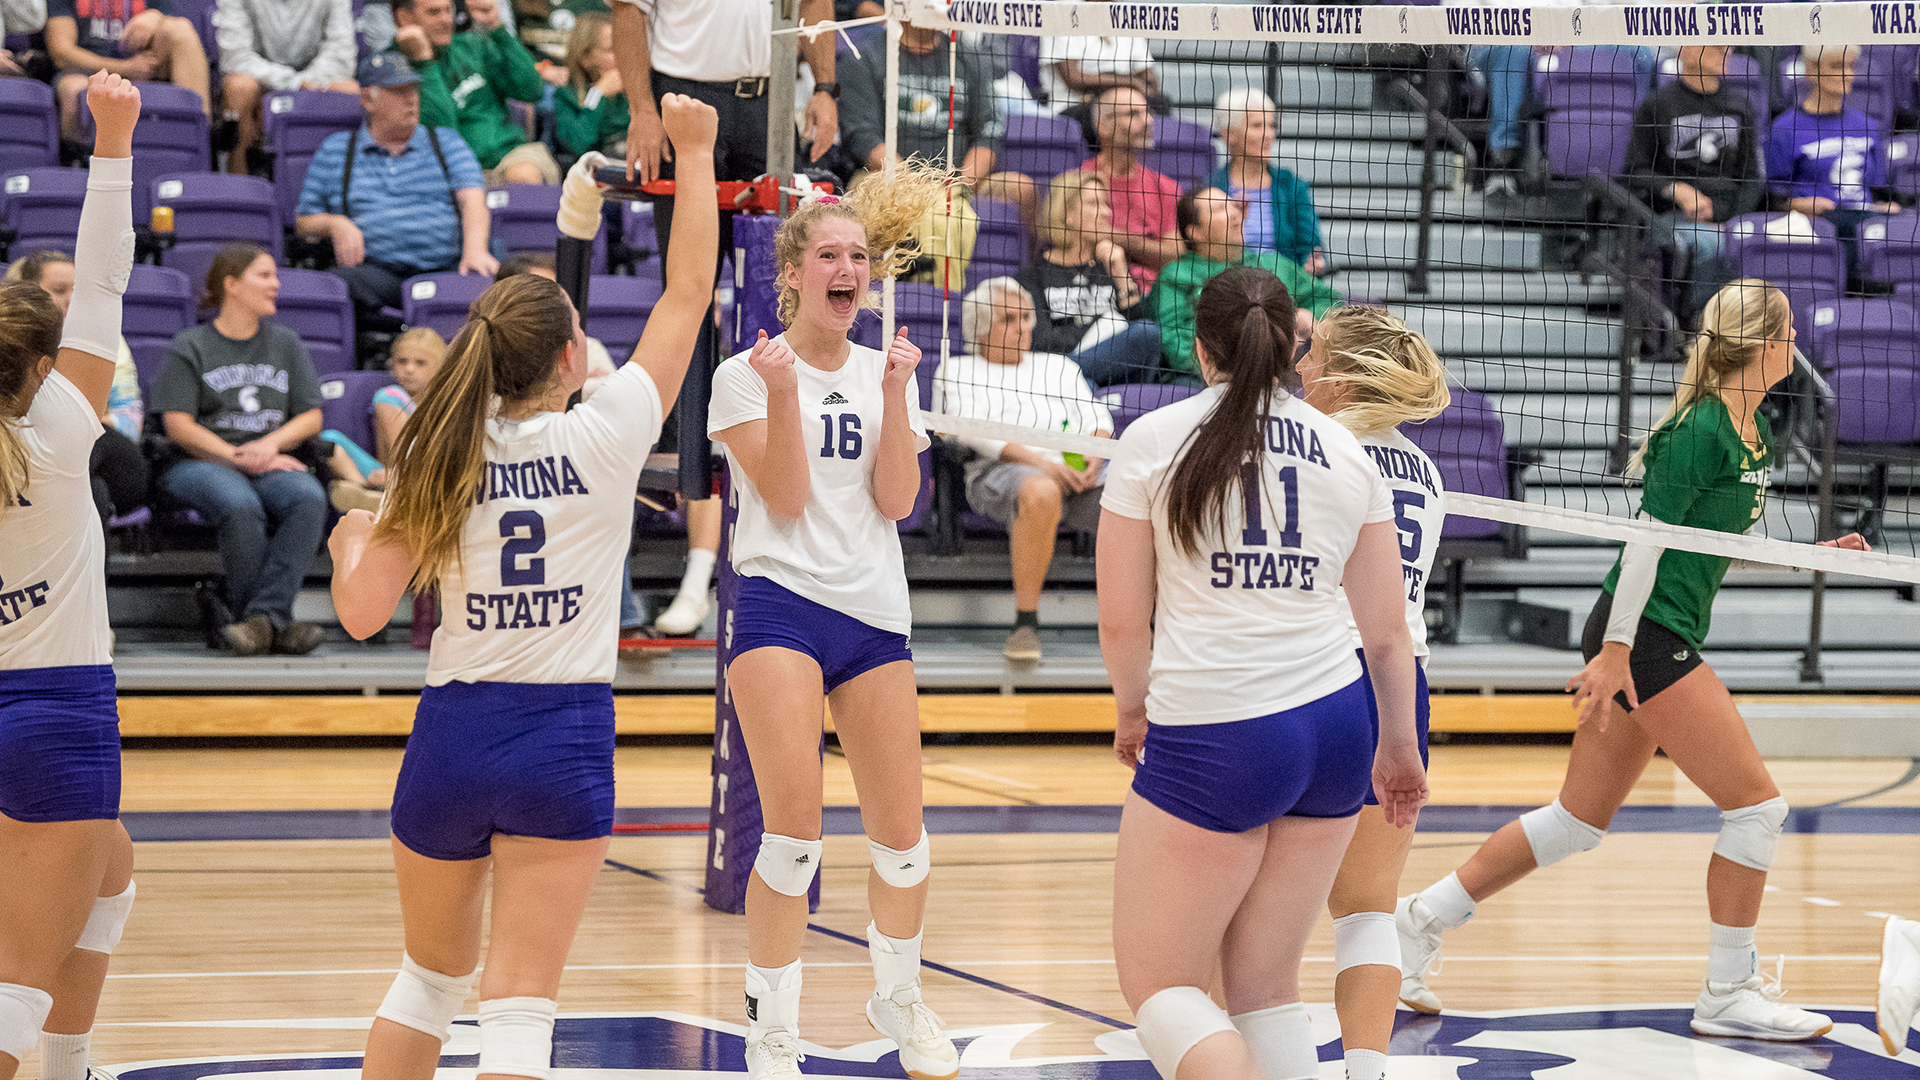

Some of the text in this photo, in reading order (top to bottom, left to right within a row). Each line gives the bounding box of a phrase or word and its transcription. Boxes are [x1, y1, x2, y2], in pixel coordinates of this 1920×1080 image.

[947, 0, 1042, 27] WINONA STATE
[1110, 4, 1179, 31] WARRIORS
[1252, 6, 1362, 34] WINONA STATE
[1446, 7, 1532, 36] WARRIORS
[1624, 5, 1764, 36] WINONA STATE
[1870, 3, 1920, 34] WAR
[820, 413, 863, 460] 16
[1240, 461, 1302, 549] 11
[1391, 489, 1426, 564] 5
[498, 510, 546, 587] 2
[1211, 552, 1320, 591] STATE
[466, 584, 584, 632] STATE
